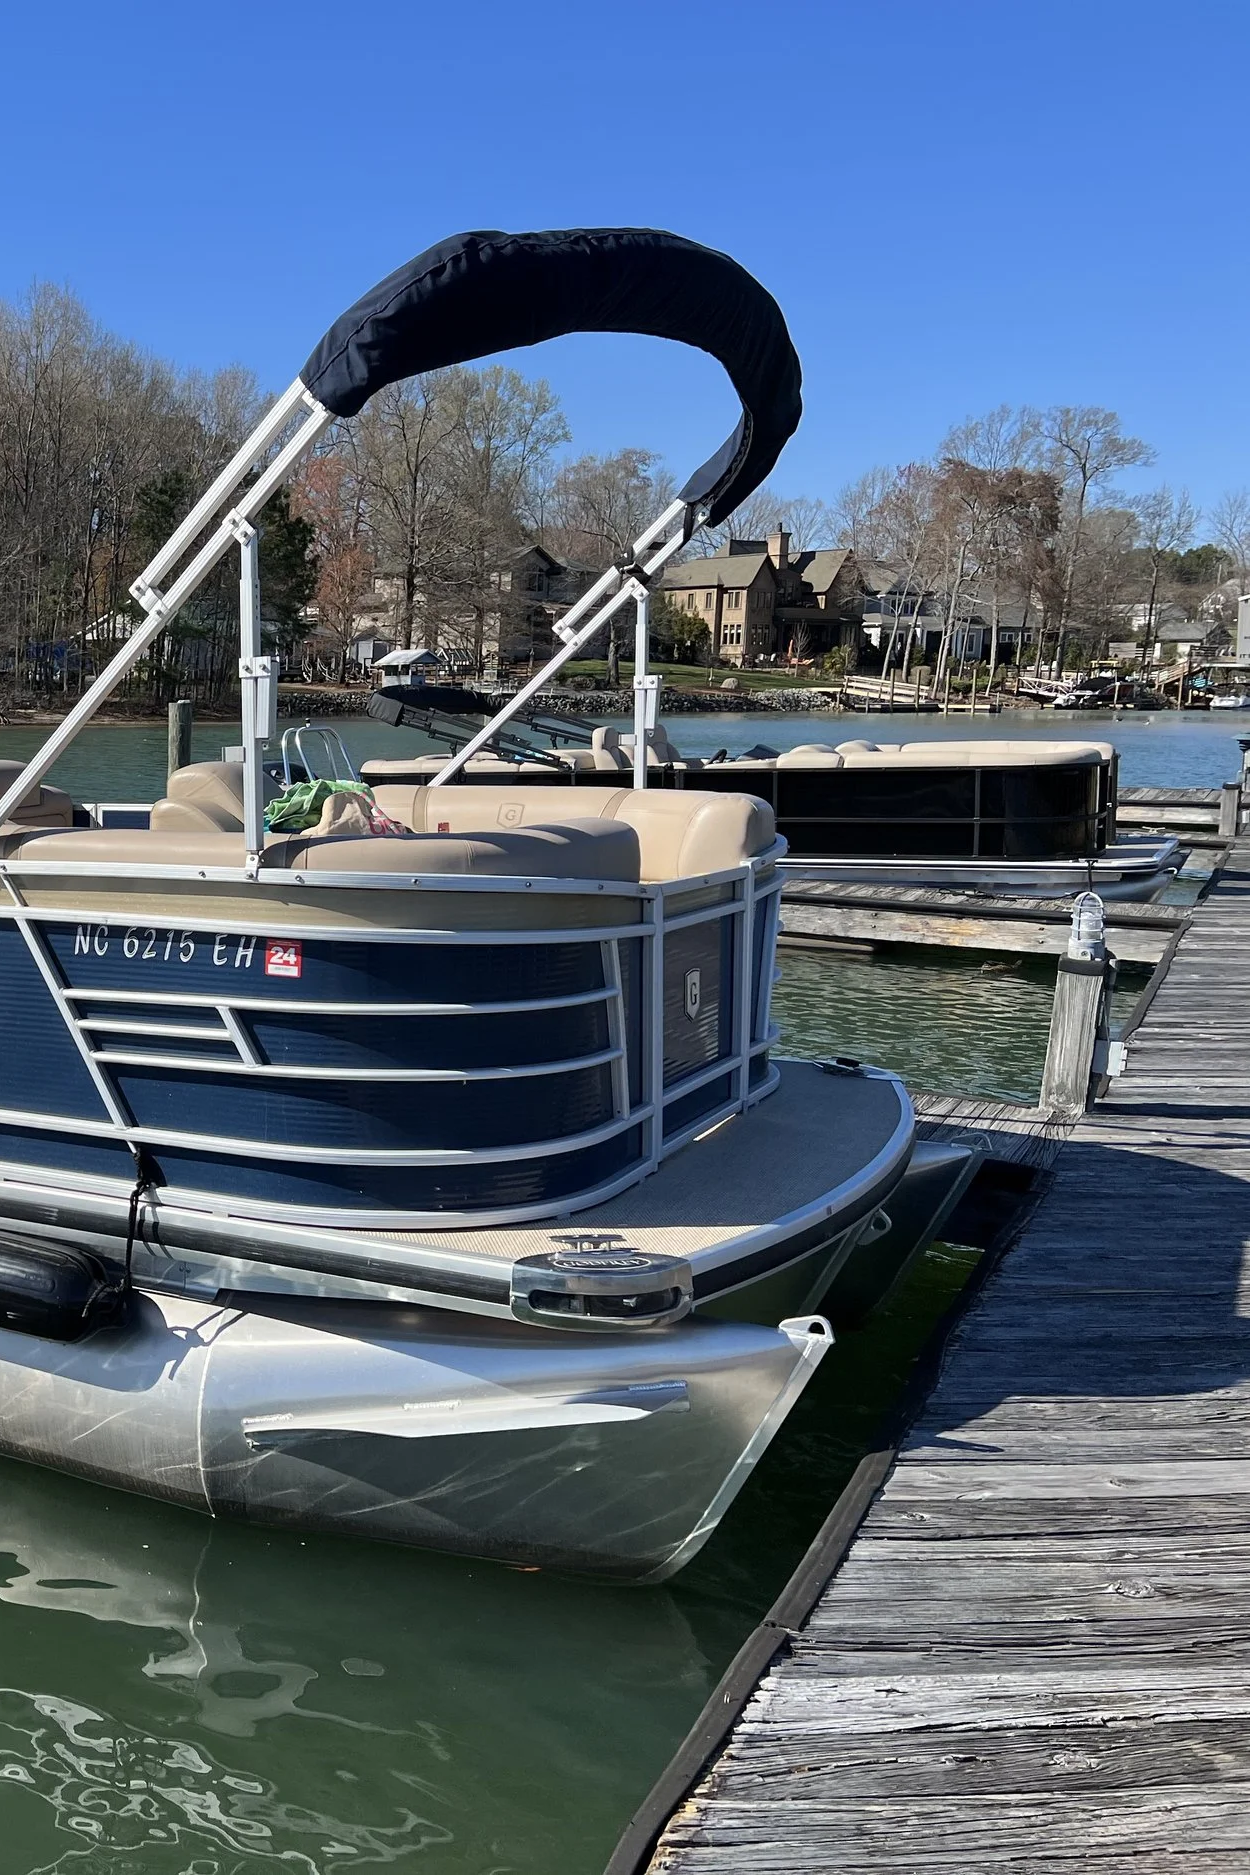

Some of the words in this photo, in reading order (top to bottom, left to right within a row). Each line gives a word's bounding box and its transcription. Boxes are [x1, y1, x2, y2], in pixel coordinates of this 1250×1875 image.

[74, 924, 109, 956] NC
[123, 926, 195, 963] 6215
[213, 934, 257, 968] EH
[270, 946, 297, 965] 24
